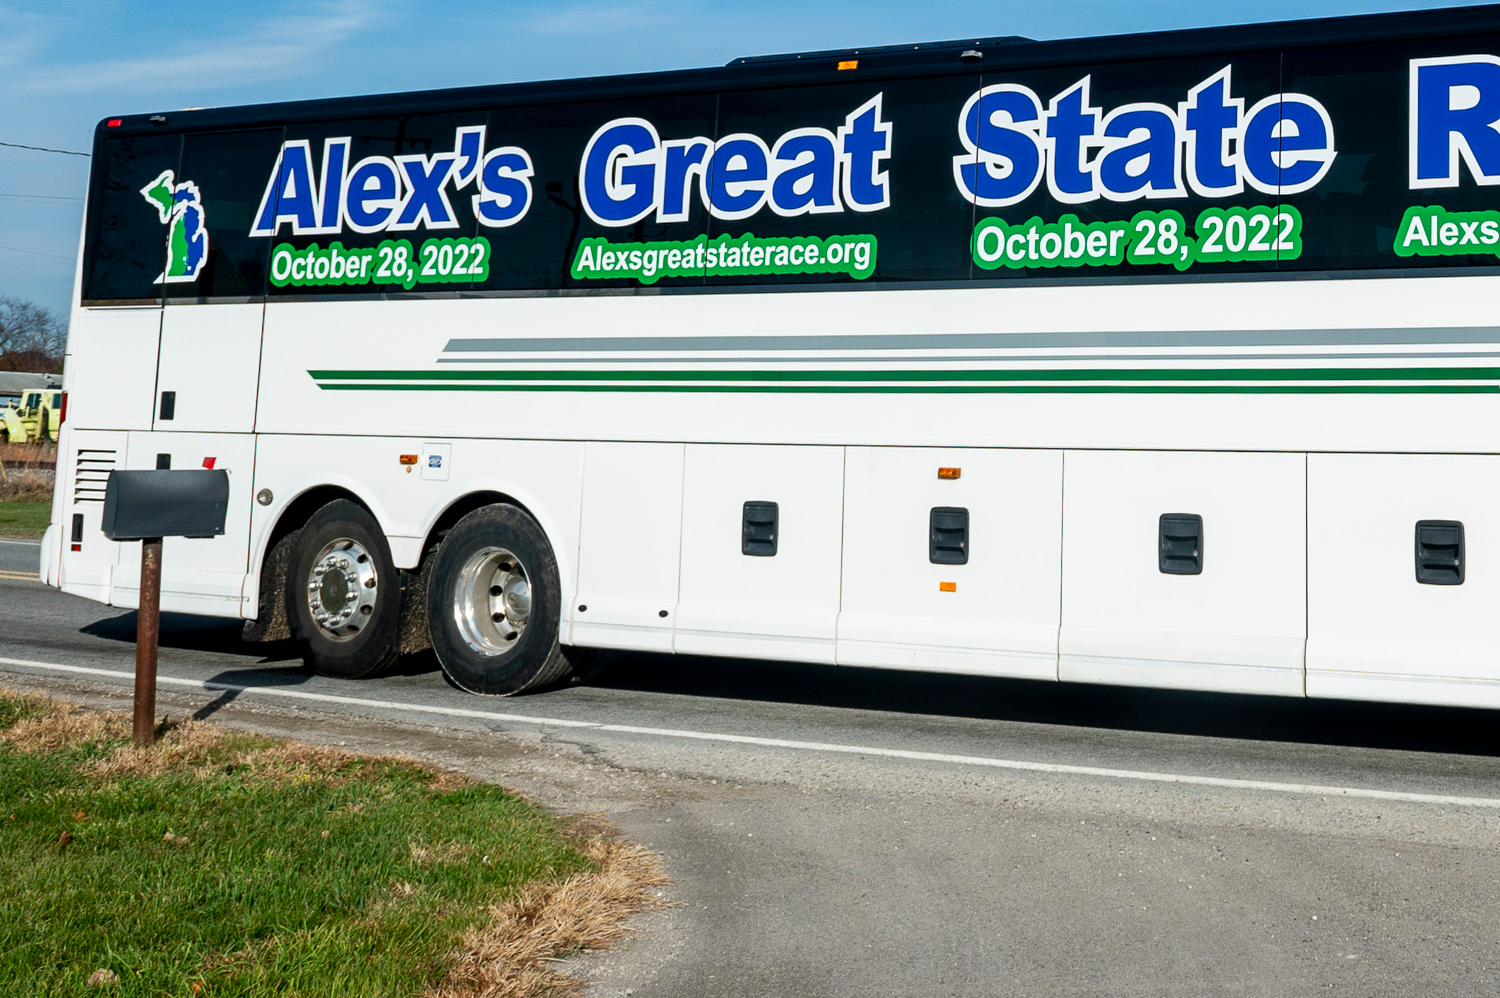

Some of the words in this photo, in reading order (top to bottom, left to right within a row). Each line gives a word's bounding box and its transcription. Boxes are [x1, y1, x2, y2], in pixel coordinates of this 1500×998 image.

[249, 125, 534, 237] Alex's
[579, 92, 892, 227] Great
[953, 64, 1338, 207] State
[576, 241, 871, 277] Alexsgreatstaterace.org
[976, 223, 1126, 262] October
[1133, 218, 1188, 262] 28,
[1201, 212, 1294, 253] 2022
[272, 248, 374, 281] October
[376, 247, 414, 282] 28,
[421, 244, 485, 276] 2022
